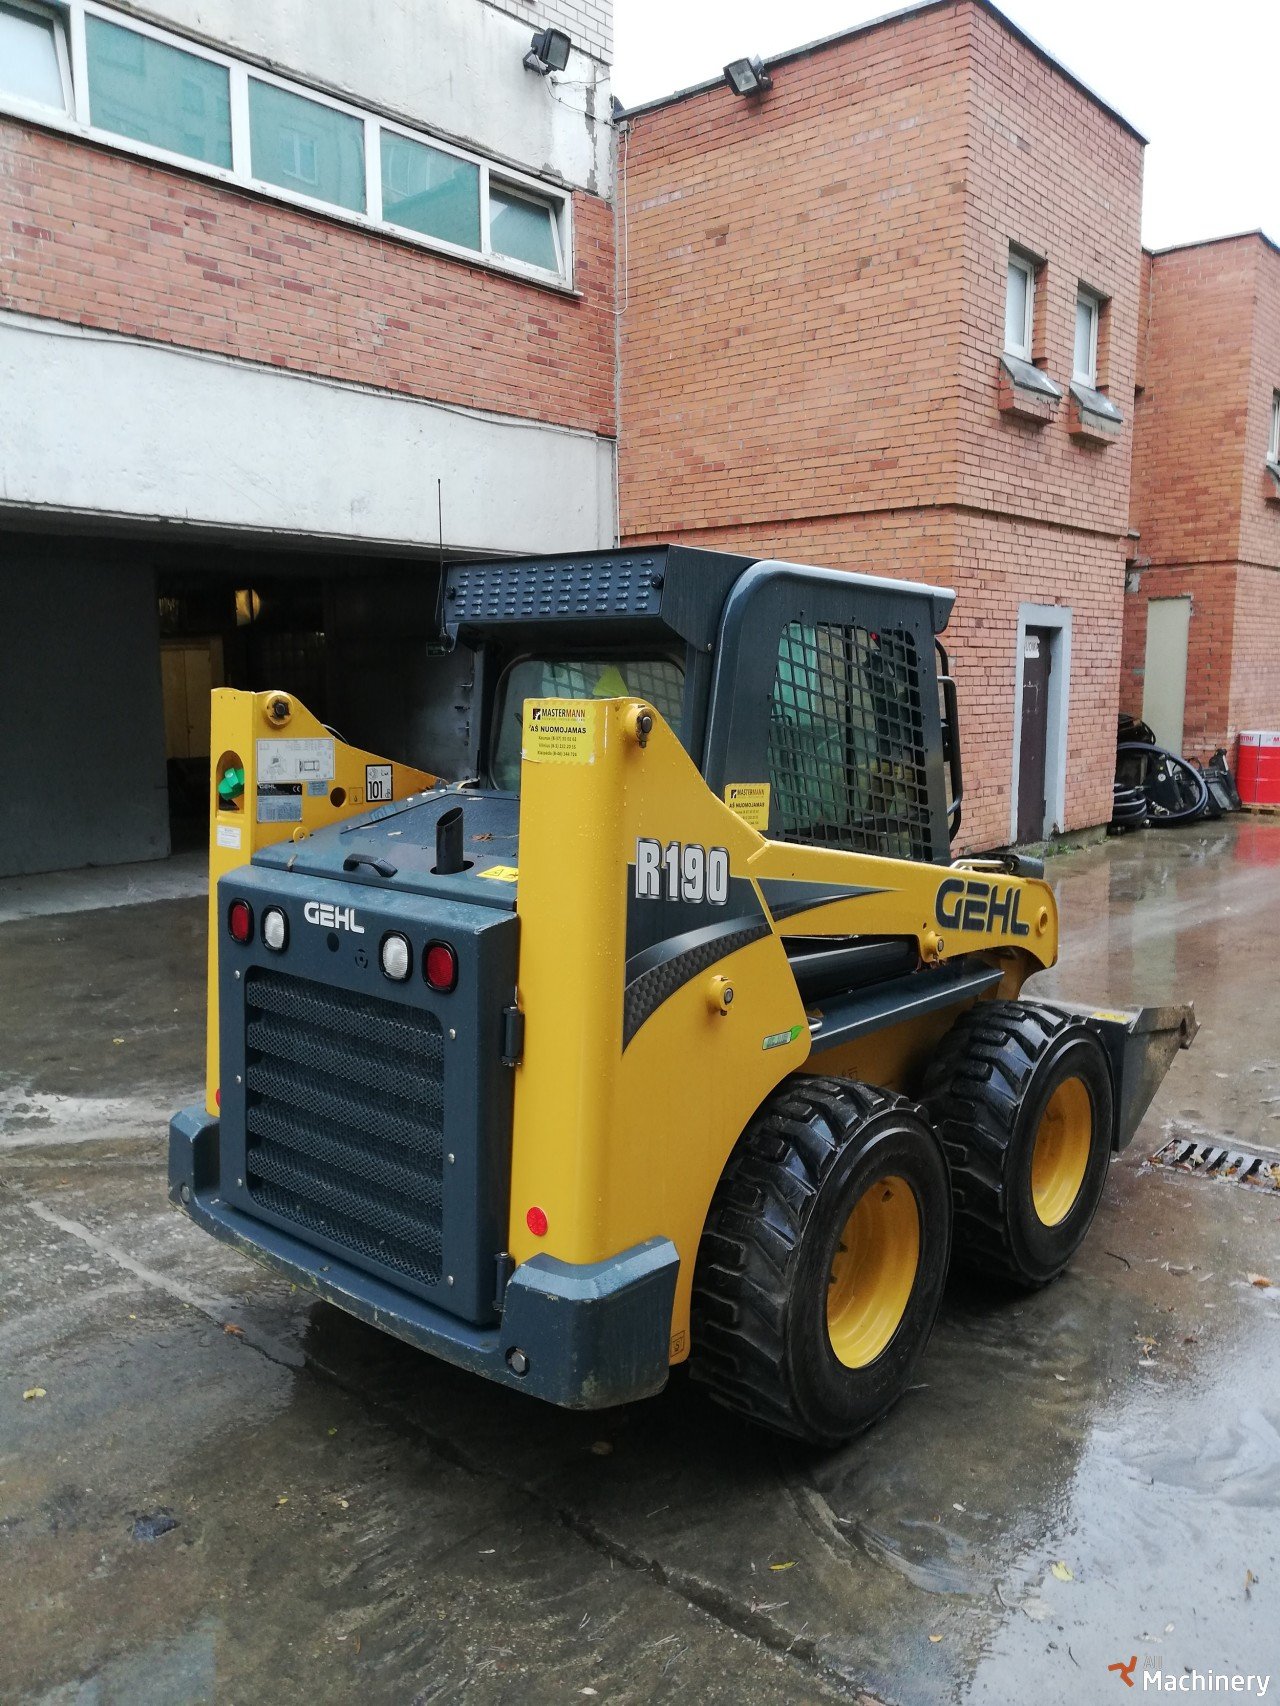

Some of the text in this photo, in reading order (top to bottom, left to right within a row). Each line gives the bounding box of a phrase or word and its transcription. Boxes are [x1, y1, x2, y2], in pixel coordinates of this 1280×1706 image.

[541, 708, 586, 718] MASTERMANN
[540, 726, 587, 734] NUOMOJAMAS
[368, 780, 383, 799] 101
[737, 788, 765, 796] MASTERMANN
[635, 837, 730, 906] R190
[935, 878, 1030, 936] GEHL
[303, 901, 365, 934] GEHL
